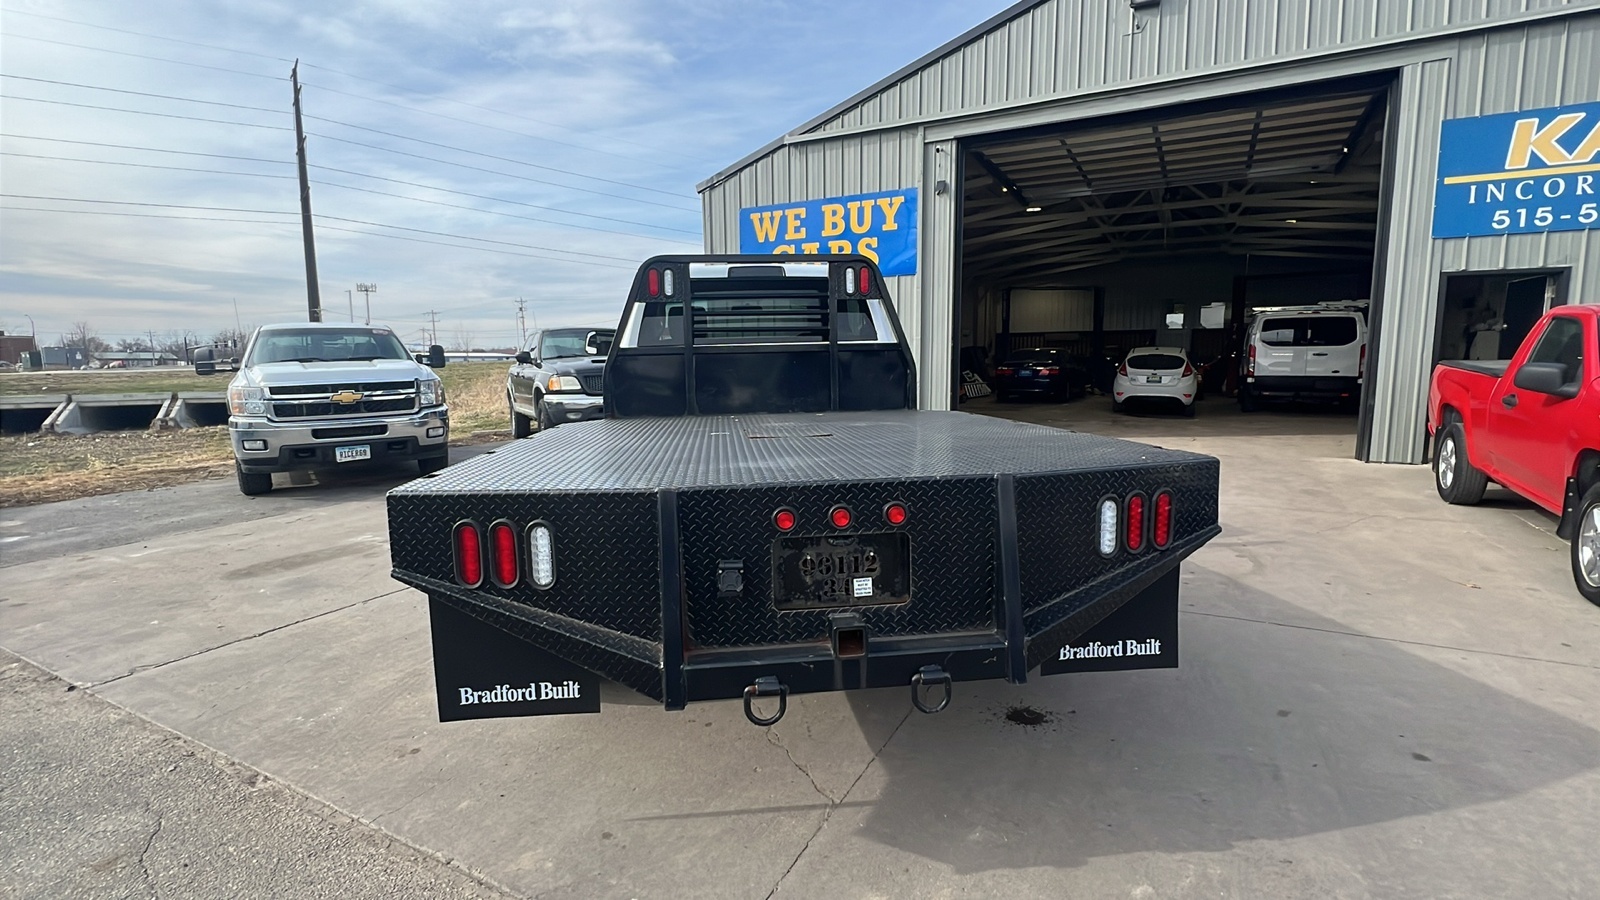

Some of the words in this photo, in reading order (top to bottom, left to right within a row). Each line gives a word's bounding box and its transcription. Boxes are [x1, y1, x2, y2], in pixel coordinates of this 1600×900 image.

[1469, 175, 1594, 204] INCOR
[750, 207, 806, 243] WE
[821, 196, 905, 237] BUY
[1491, 203, 1598, 229] 515-5
[801, 553, 878, 576] 96112
[1058, 640, 1123, 661] Bradford
[1125, 638, 1161, 656] Built
[458, 682, 537, 705] Bradford
[539, 680, 580, 700] Built
